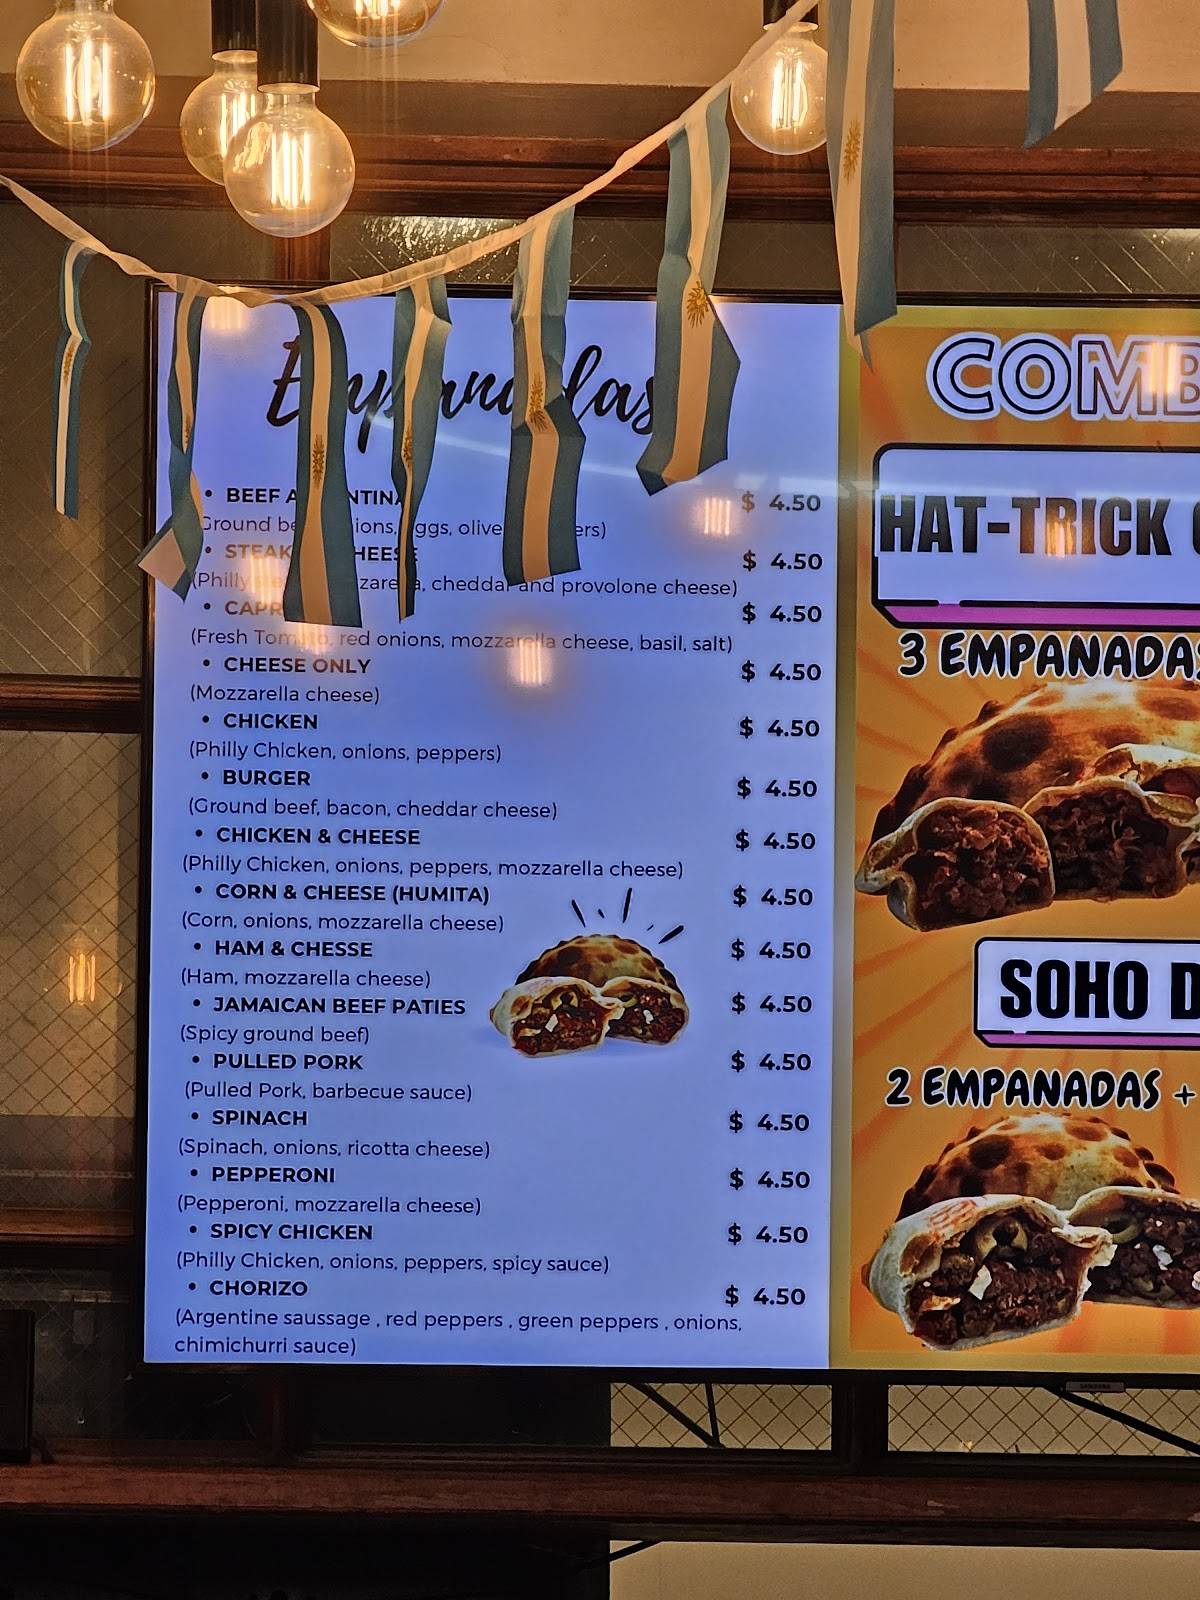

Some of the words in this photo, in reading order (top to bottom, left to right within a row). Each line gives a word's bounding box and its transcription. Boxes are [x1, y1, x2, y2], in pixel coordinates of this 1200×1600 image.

[227, 488, 280, 503] BEEF
[741, 491, 755, 512] $
[770, 495, 821, 511] 4.50
[880, 496, 1172, 555] HAT-TRICK
[225, 544, 292, 558] STEAK
[743, 549, 756, 572] $
[770, 553, 822, 570] 4.50
[562, 578, 657, 597] provolone
[664, 579, 737, 598] cheese)
[742, 602, 756, 624] $
[770, 605, 822, 622] 4.50
[191, 629, 248, 646] (Fresh
[340, 630, 370, 646] red
[377, 631, 445, 649] onions,
[563, 634, 633, 651] cheese,
[640, 634, 686, 652] basil,
[692, 636, 732, 654] salt)
[224, 657, 306, 673] CHEESE
[313, 658, 371, 673] ONLY
[900, 633, 925, 675] 3
[941, 632, 1200, 678] EMPANADA
[741, 660, 755, 683] $
[770, 663, 821, 681] 4.50
[191, 684, 298, 702] (Mozzarella
[306, 686, 379, 705] cheese)
[224, 713, 317, 729] CHICKEN
[740, 716, 753, 739] $
[768, 720, 819, 737] 4.50
[190, 740, 248, 761] (Philly
[254, 742, 336, 760] Chicken,
[343, 743, 409, 761] onions,
[417, 744, 501, 764] peppers)
[223, 770, 310, 786] BURGER
[737, 776, 751, 800] $
[765, 780, 817, 797] 4.50
[189, 797, 266, 816] (Ground
[275, 798, 320, 816] beef,
[327, 798, 390, 817] bacon,
[397, 800, 478, 817] cheddar
[484, 801, 557, 821] cheese)
[217, 827, 311, 843] CHICKEN
[318, 829, 331, 844] &
[338, 829, 420, 845] CHEESE
[736, 828, 749, 852] $
[764, 832, 815, 849] 4.50
[183, 854, 241, 875] (Philly
[247, 856, 329, 874] Chicken,
[336, 857, 403, 875] onions,
[410, 862, 491, 878] peppers,
[499, 860, 603, 876] mozzarella
[610, 861, 682, 880] cheese)
[216, 884, 276, 900] CORN
[283, 885, 296, 899] &
[304, 885, 386, 901] CHEESE
[391, 885, 489, 906] (HUMITA)
[733, 884, 747, 908] $
[761, 888, 813, 906] 4.50
[182, 911, 237, 930] (Corn,
[244, 912, 311, 930] onions,
[319, 914, 423, 930] mozzarella
[430, 914, 503, 933] cheese)
[216, 940, 263, 956] HAM
[270, 941, 284, 956] &
[291, 941, 373, 957] CHESSE
[731, 938, 745, 961] $
[759, 941, 811, 959] 4.50
[182, 968, 238, 986] (Ham,
[245, 969, 349, 985] mozzarella
[357, 970, 430, 989] cheese)
[1000, 959, 1149, 1020] SOHO
[213, 997, 325, 1013] JAMAICAN
[333, 998, 386, 1014] BEEF
[391, 999, 465, 1014] PATIES
[732, 992, 745, 1015] $
[760, 995, 812, 1013] 4.50
[181, 1024, 238, 1045] (Spicy
[244, 1026, 313, 1044] ground
[321, 1026, 369, 1045] beef)
[214, 1054, 296, 1069] PULLED
[304, 1055, 363, 1071] PORK
[731, 1050, 745, 1073] $
[759, 1053, 811, 1071] 4.50
[186, 1081, 251, 1099] (Pulled
[260, 1082, 306, 1099] Pork,
[313, 1082, 404, 1099] barbecue
[410, 1084, 471, 1103] sauce)
[886, 1070, 911, 1105] 2
[923, 1068, 1161, 1109] EMPANADAS
[212, 1110, 307, 1126] SPINACH
[729, 1110, 743, 1133] $
[757, 1114, 809, 1131] 4.50
[179, 1137, 267, 1158] (Spinach,
[274, 1139, 341, 1156] onions,
[348, 1140, 409, 1156] ricotta
[416, 1140, 489, 1159] cheese)
[212, 1167, 334, 1183] PEPPERONI
[730, 1167, 743, 1191] $
[758, 1171, 810, 1189] 4.50
[178, 1194, 288, 1214] (Pepperoni,
[296, 1196, 400, 1212] mozzarella
[407, 1197, 480, 1216] cheese)
[210, 1224, 273, 1239] SPICY
[279, 1224, 372, 1240] CHICKEN
[728, 1222, 742, 1246] $
[756, 1226, 808, 1243] 4.50
[177, 1251, 236, 1271] (Philly
[241, 1252, 323, 1270] Chicken,
[330, 1253, 397, 1270] onions,
[405, 1258, 486, 1274] peppers,
[492, 1255, 542, 1275] spicy
[546, 1256, 608, 1274] sauce)
[210, 1280, 308, 1296] CHORIZO
[725, 1284, 739, 1308] $
[753, 1288, 805, 1305] 4.50
[176, 1308, 278, 1328] (Argentine
[386, 1310, 417, 1326] red
[519, 1316, 573, 1331] green
[674, 1314, 741, 1331] onions,
[175, 1336, 287, 1353] chimichurri
[293, 1338, 355, 1356] sauce)
